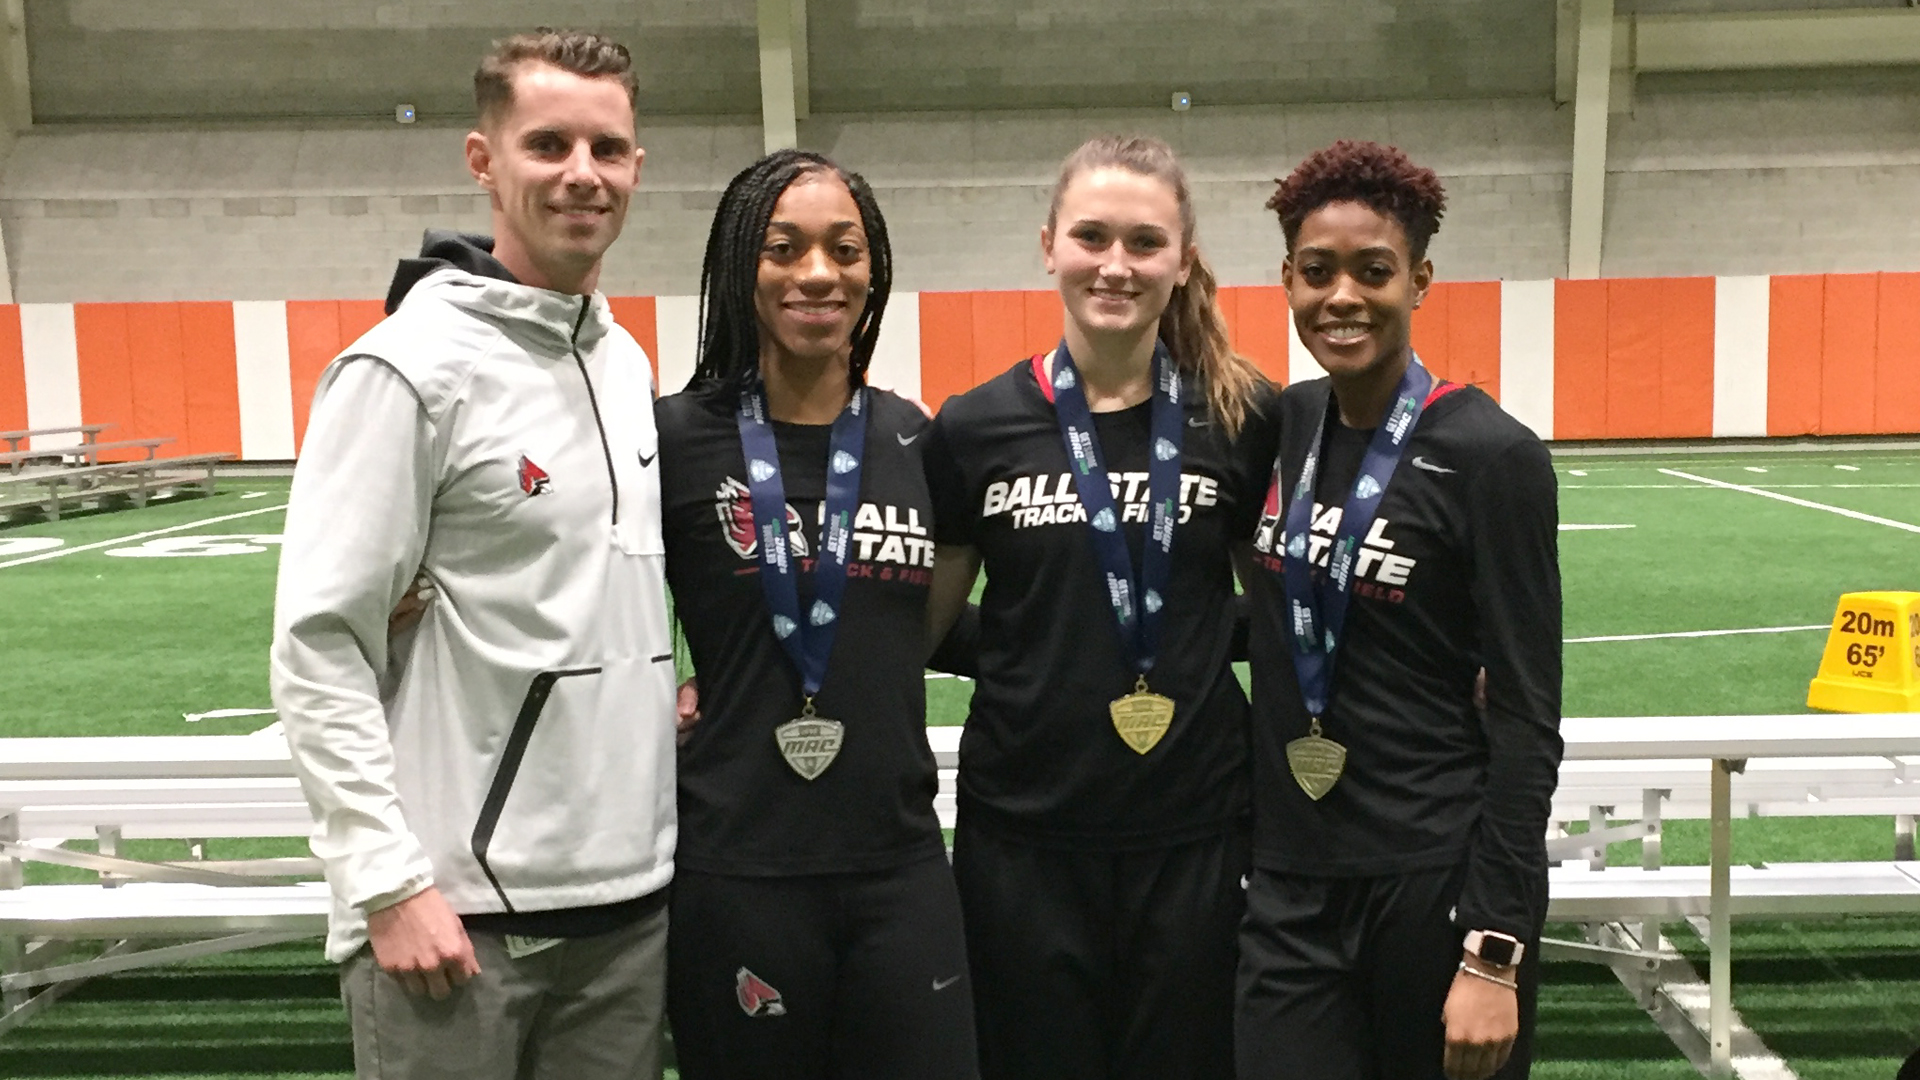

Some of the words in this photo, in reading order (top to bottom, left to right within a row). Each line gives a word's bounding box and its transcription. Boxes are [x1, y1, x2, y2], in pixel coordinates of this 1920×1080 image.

[983, 473, 1078, 517] BALL
[1107, 472, 1218, 506] STTE
[1012, 504, 1087, 529] TRACK
[1122, 504, 1191, 524] FID
[1311, 503, 1395, 549] AL
[802, 559, 873, 579] TCK
[880, 567, 893, 581] &
[1841, 610, 1894, 637] 20m
[783, 739, 839, 755] MAC
